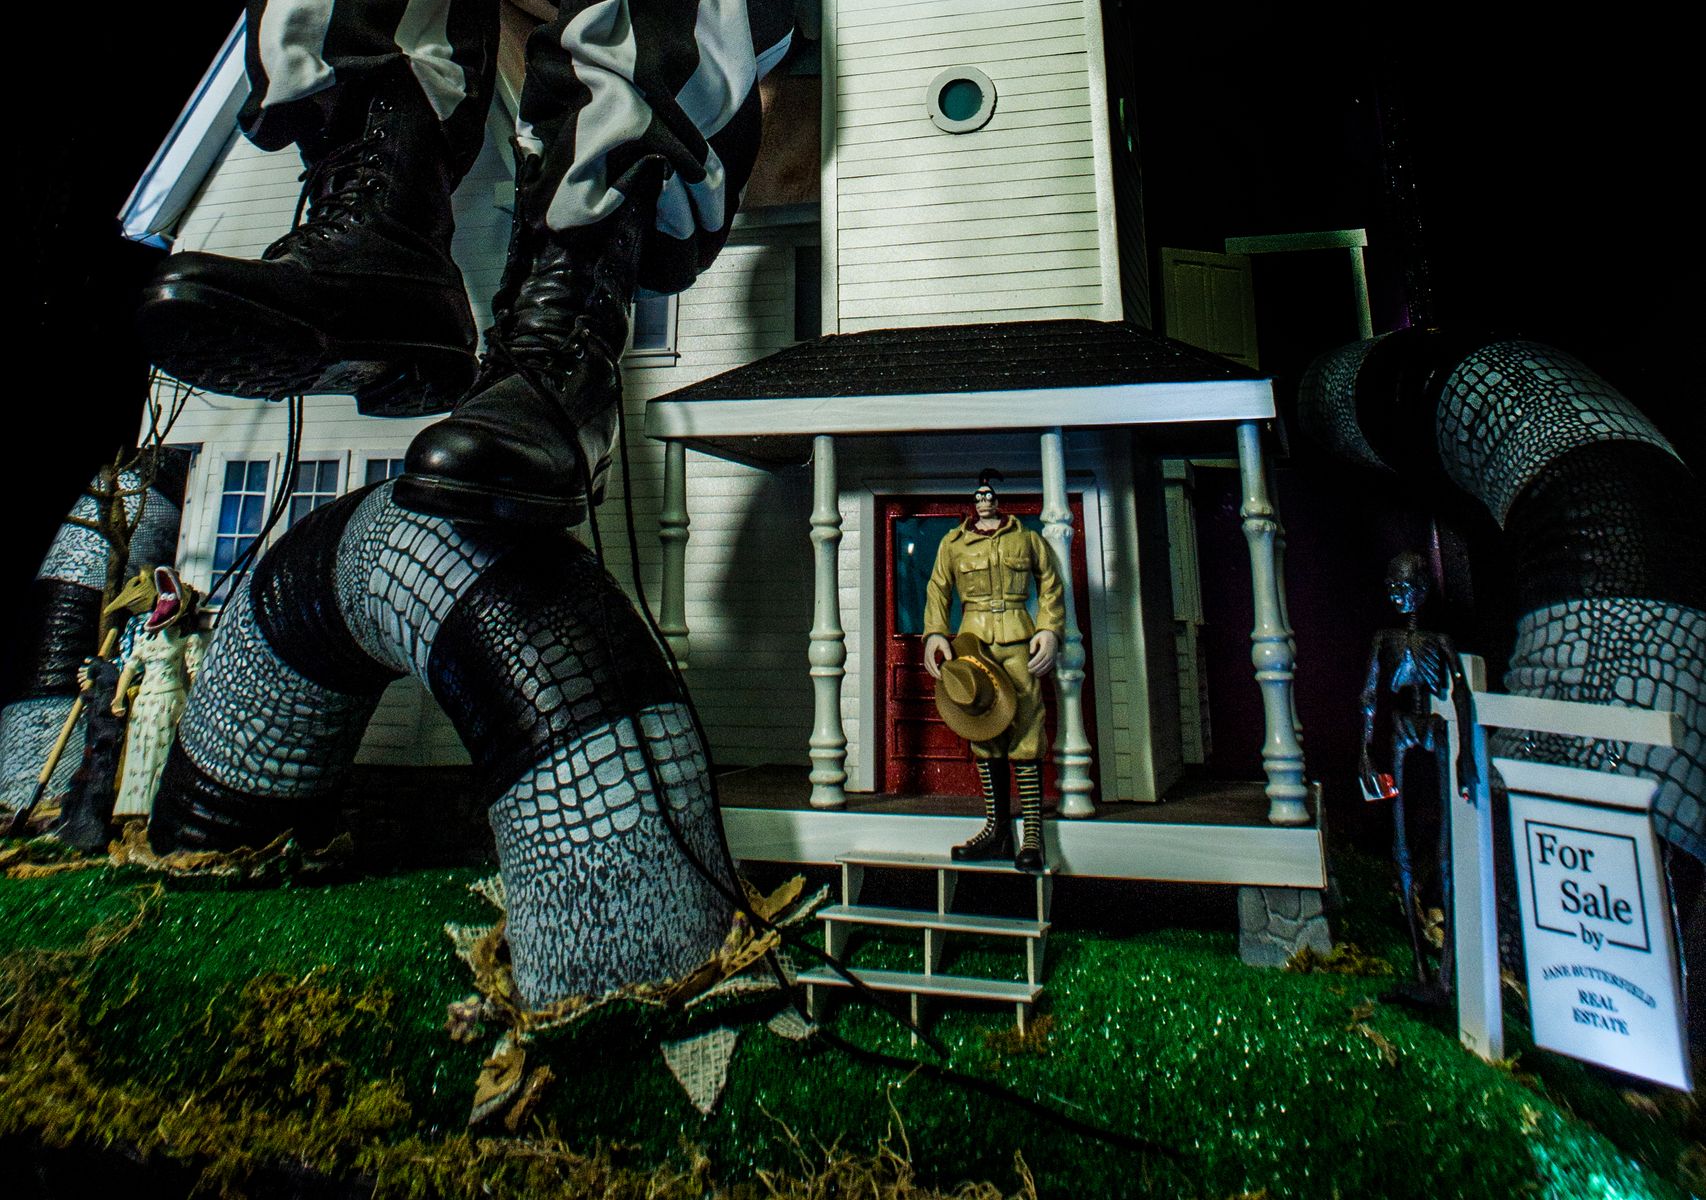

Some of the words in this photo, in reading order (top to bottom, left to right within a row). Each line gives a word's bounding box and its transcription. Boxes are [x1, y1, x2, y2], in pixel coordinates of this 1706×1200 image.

[1536, 833, 1594, 872] For
[1561, 880, 1632, 924] Sale
[1579, 921, 1604, 951] by
[1542, 965, 1571, 980] JANE
[1578, 989, 1617, 1011] REAL
[1573, 1008, 1629, 1035] ESTATE
